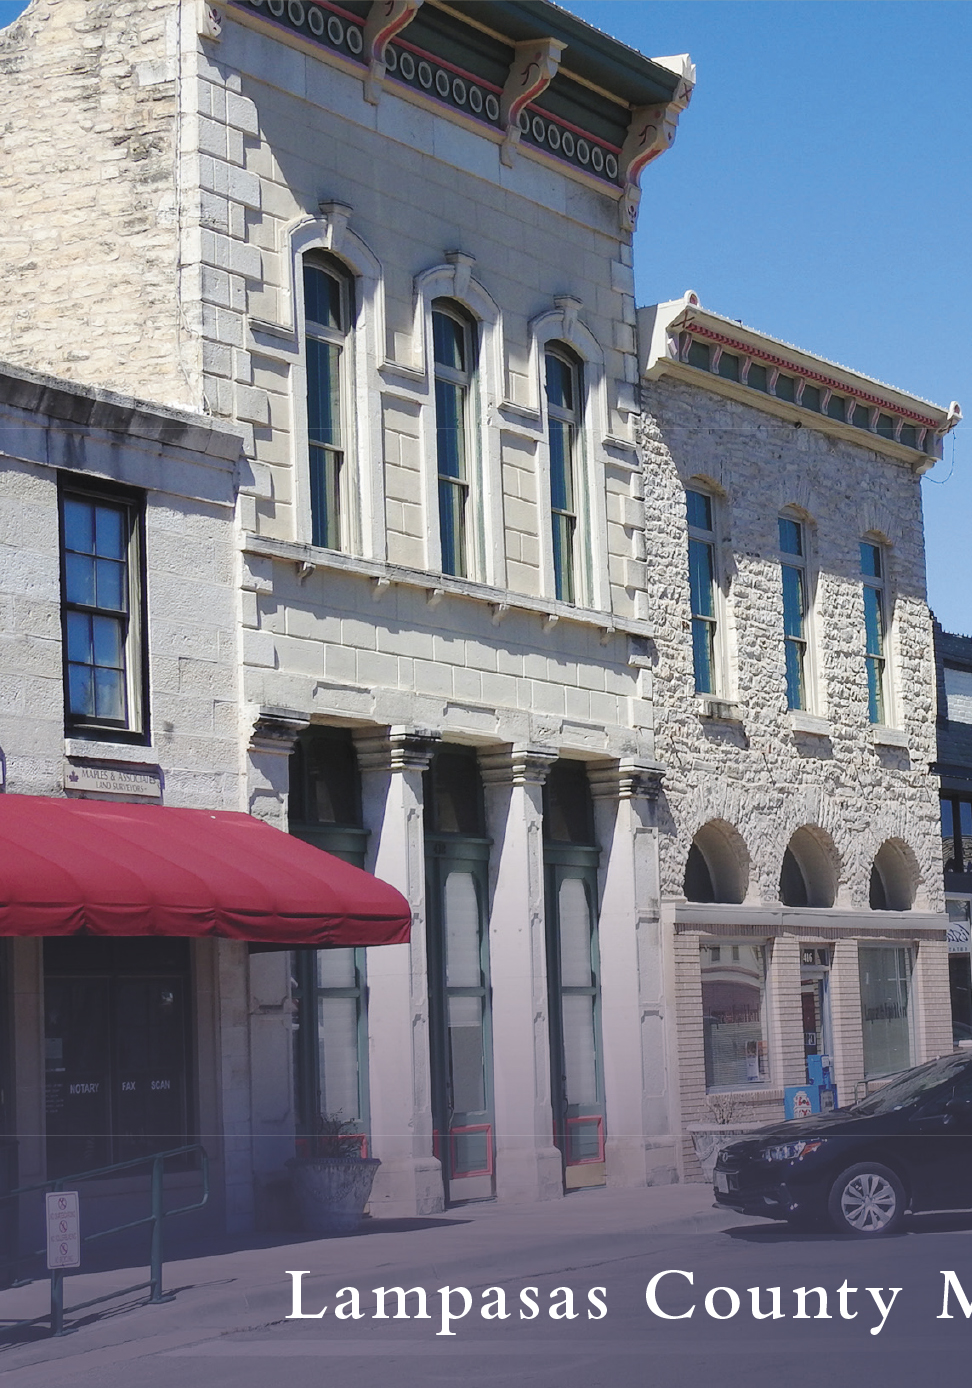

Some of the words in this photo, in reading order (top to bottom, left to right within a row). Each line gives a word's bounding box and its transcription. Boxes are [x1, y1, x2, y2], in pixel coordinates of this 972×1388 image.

[82, 769, 109, 781] MAPLES
[69, 1082, 100, 1094] NOTARY
[121, 1081, 136, 1091] FAX
[150, 1080, 171, 1090] SCAN
